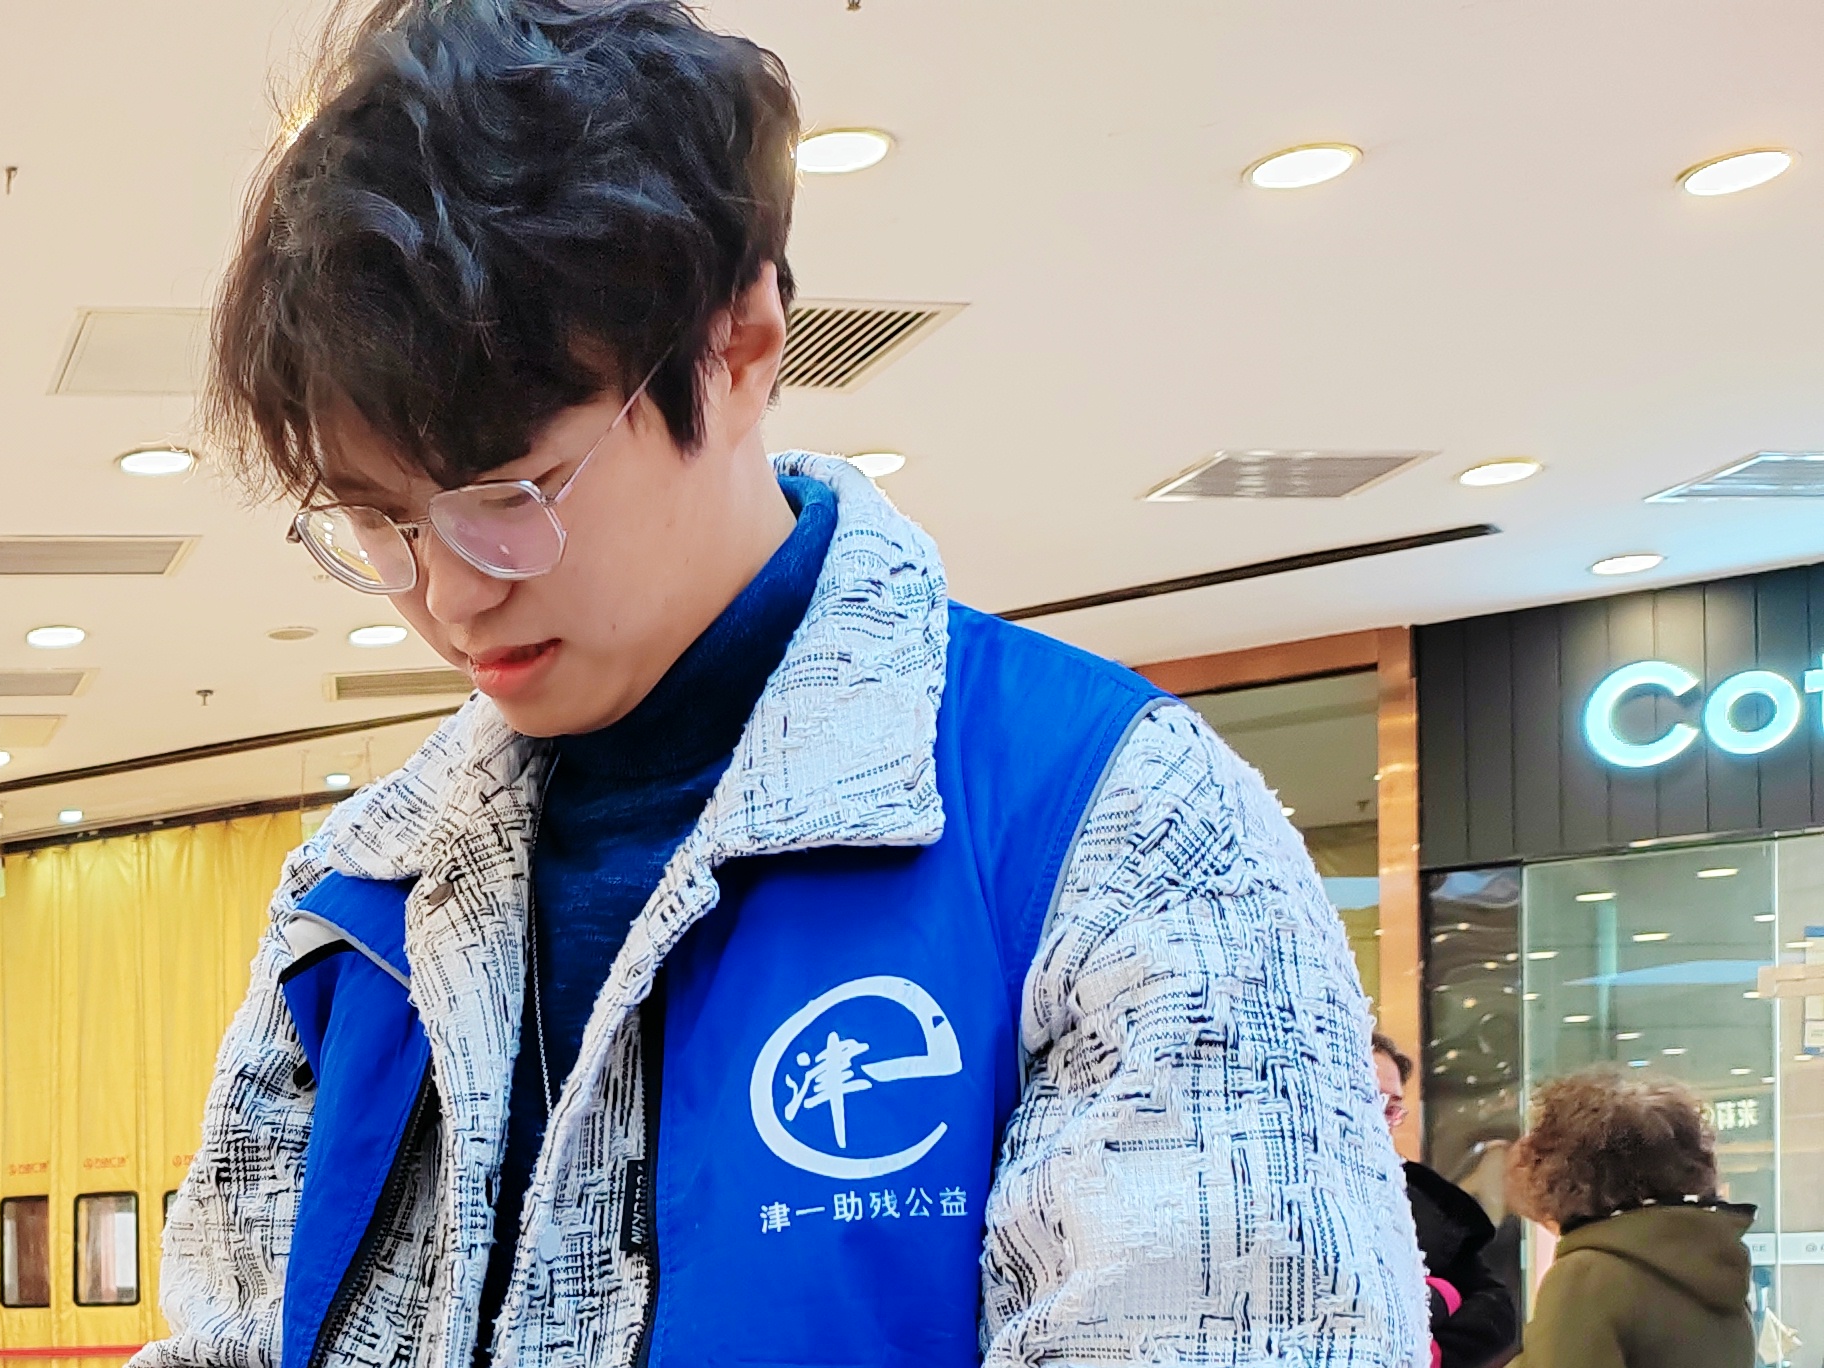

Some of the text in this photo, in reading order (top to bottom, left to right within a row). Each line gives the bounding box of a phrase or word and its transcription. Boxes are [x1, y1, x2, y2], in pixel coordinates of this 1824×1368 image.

[784, 1030, 873, 1149] 津
[759, 1186, 968, 1233] 津一助残公益
